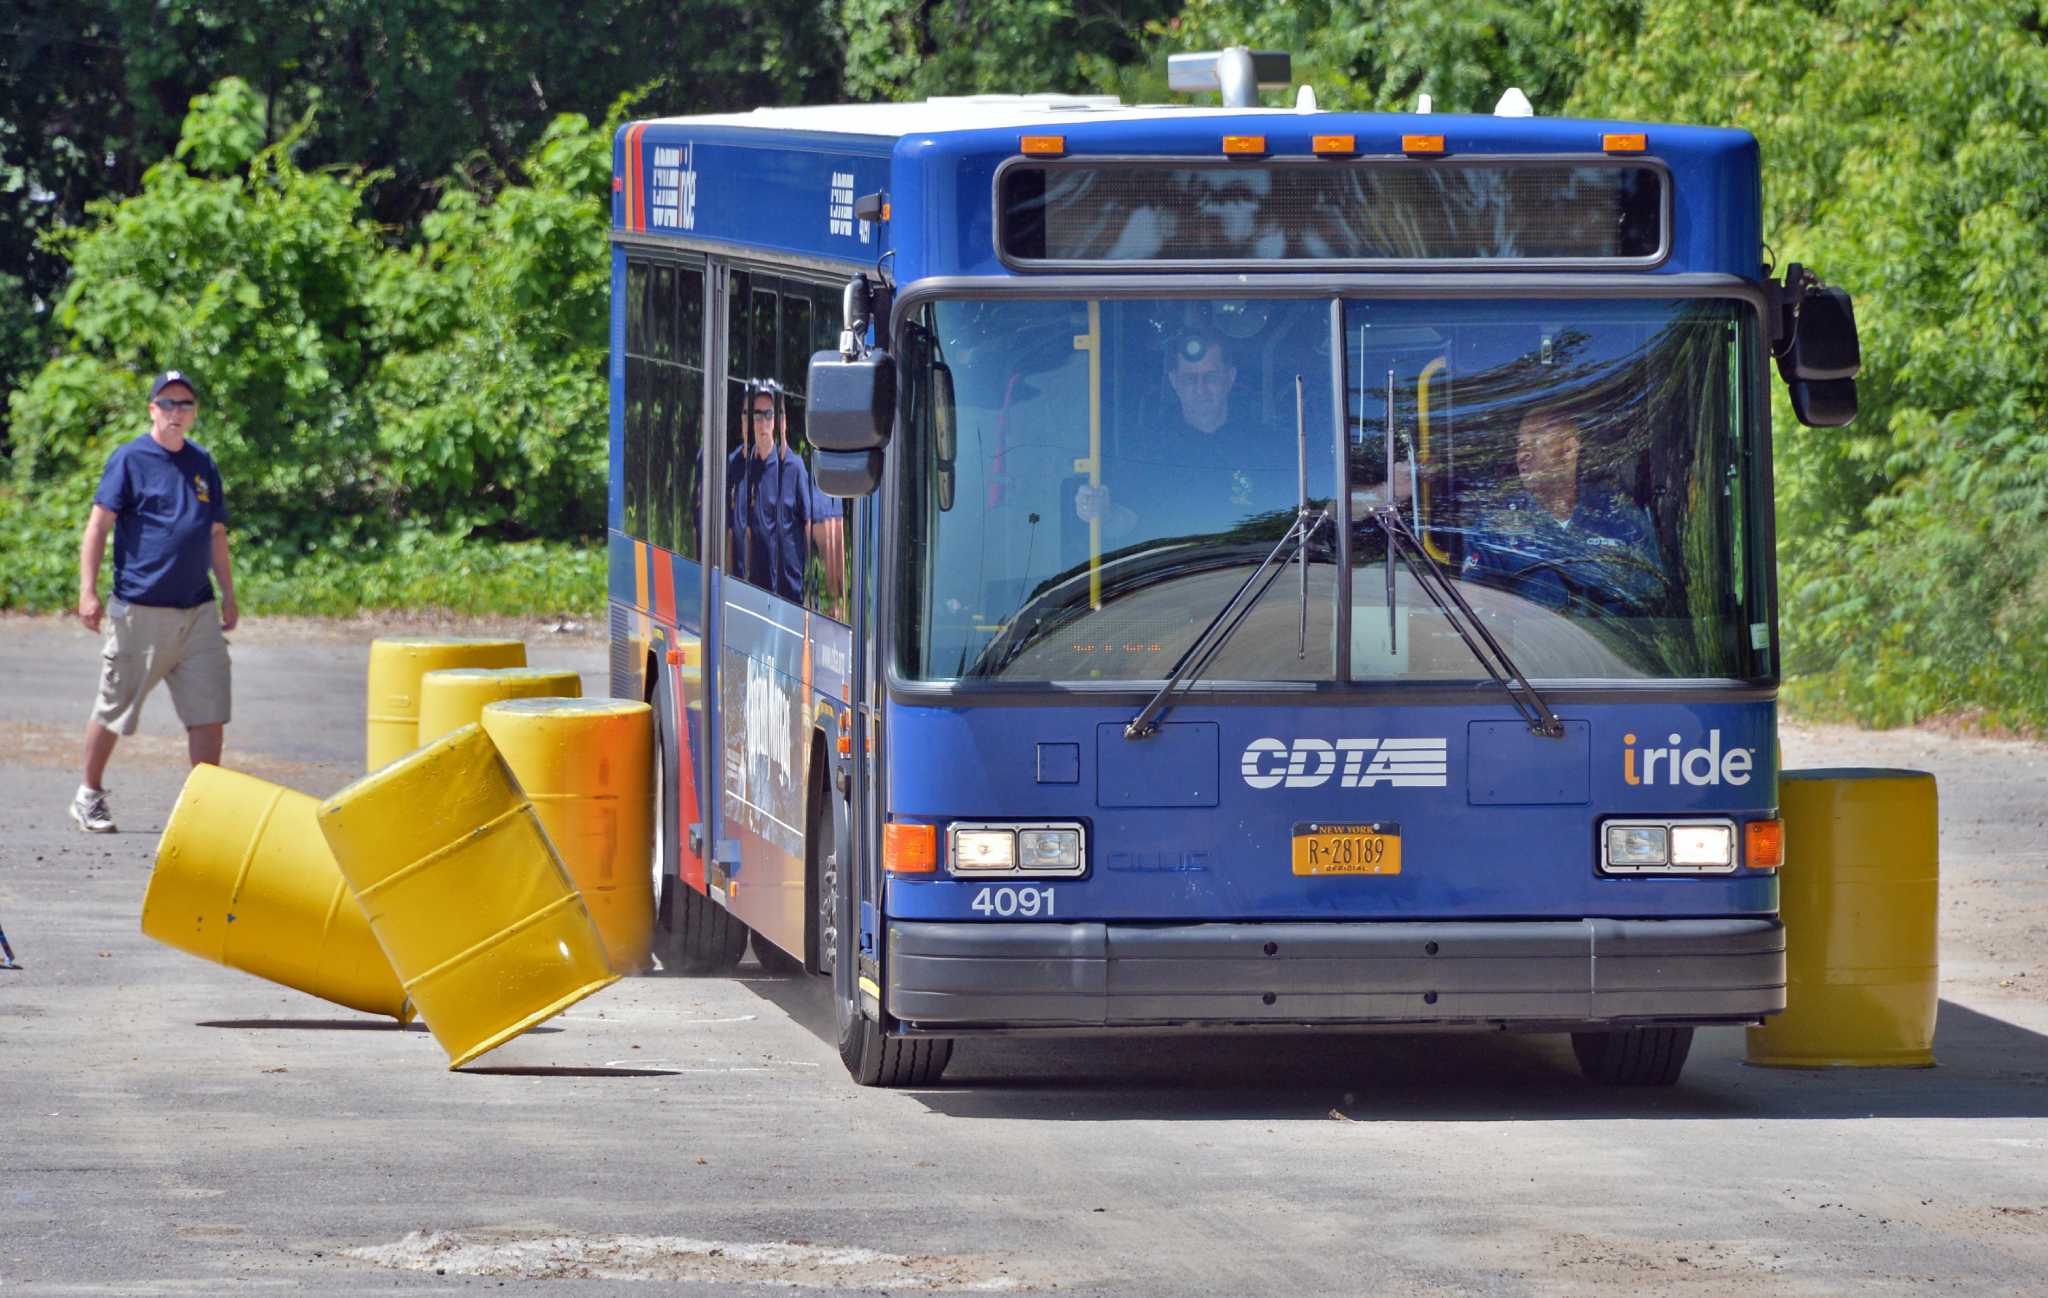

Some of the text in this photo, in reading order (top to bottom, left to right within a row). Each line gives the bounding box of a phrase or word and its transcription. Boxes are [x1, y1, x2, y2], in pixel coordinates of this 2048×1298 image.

[1241, 737, 1448, 789] CDTA
[1623, 729, 1753, 786] iride
[1319, 825, 1375, 834] NEW YORK
[971, 887, 1056, 917] 4091
